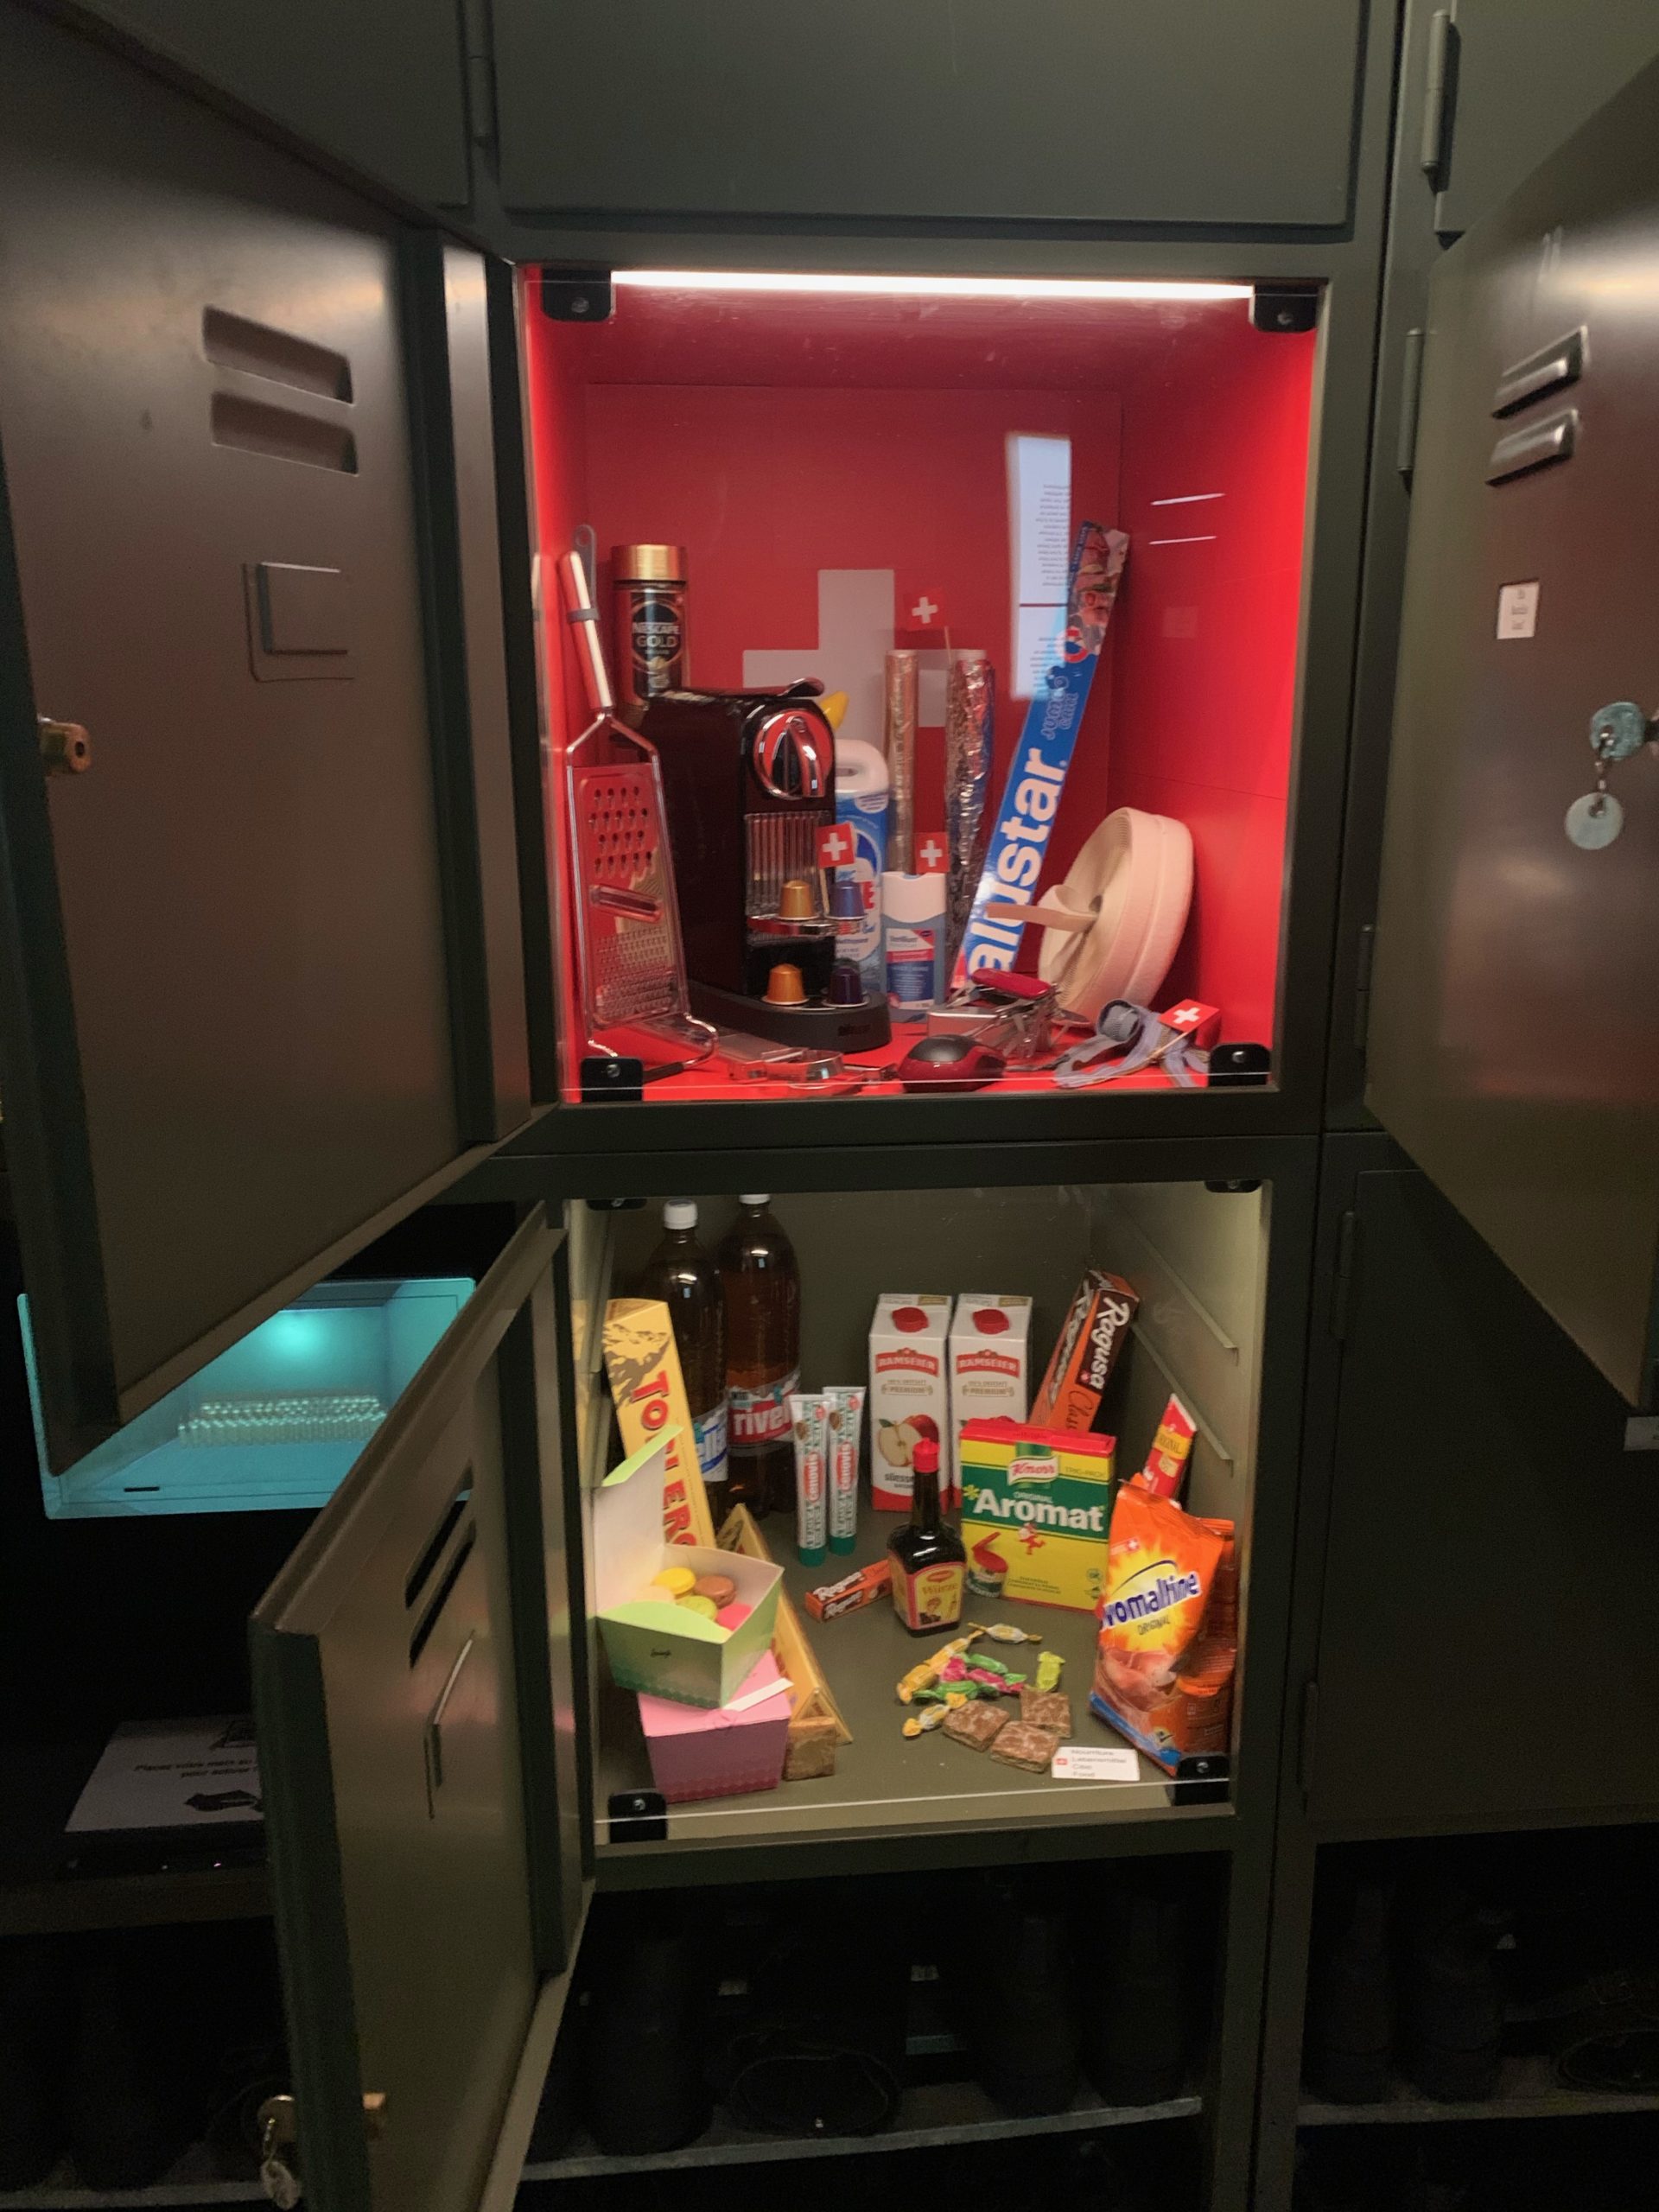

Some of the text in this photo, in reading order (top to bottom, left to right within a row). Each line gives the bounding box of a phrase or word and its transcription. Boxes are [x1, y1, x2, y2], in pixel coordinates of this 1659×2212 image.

[636, 635, 678, 648] GOLD
[1090, 1297, 1130, 1389] Ragusa
[878, 1355, 936, 1370] RAMSEIER
[959, 1357, 1017, 1372] RAMSEIER
[842, 1442, 852, 1492] cenovis
[1011, 1462, 1055, 1476] Knorr
[809, 1452, 819, 1503] cenovis
[1014, 1491, 1053, 1503] ORIGINAL
[972, 1488, 1103, 1532] Aromat
[1137, 1617, 1171, 1635] ORIGINAL
